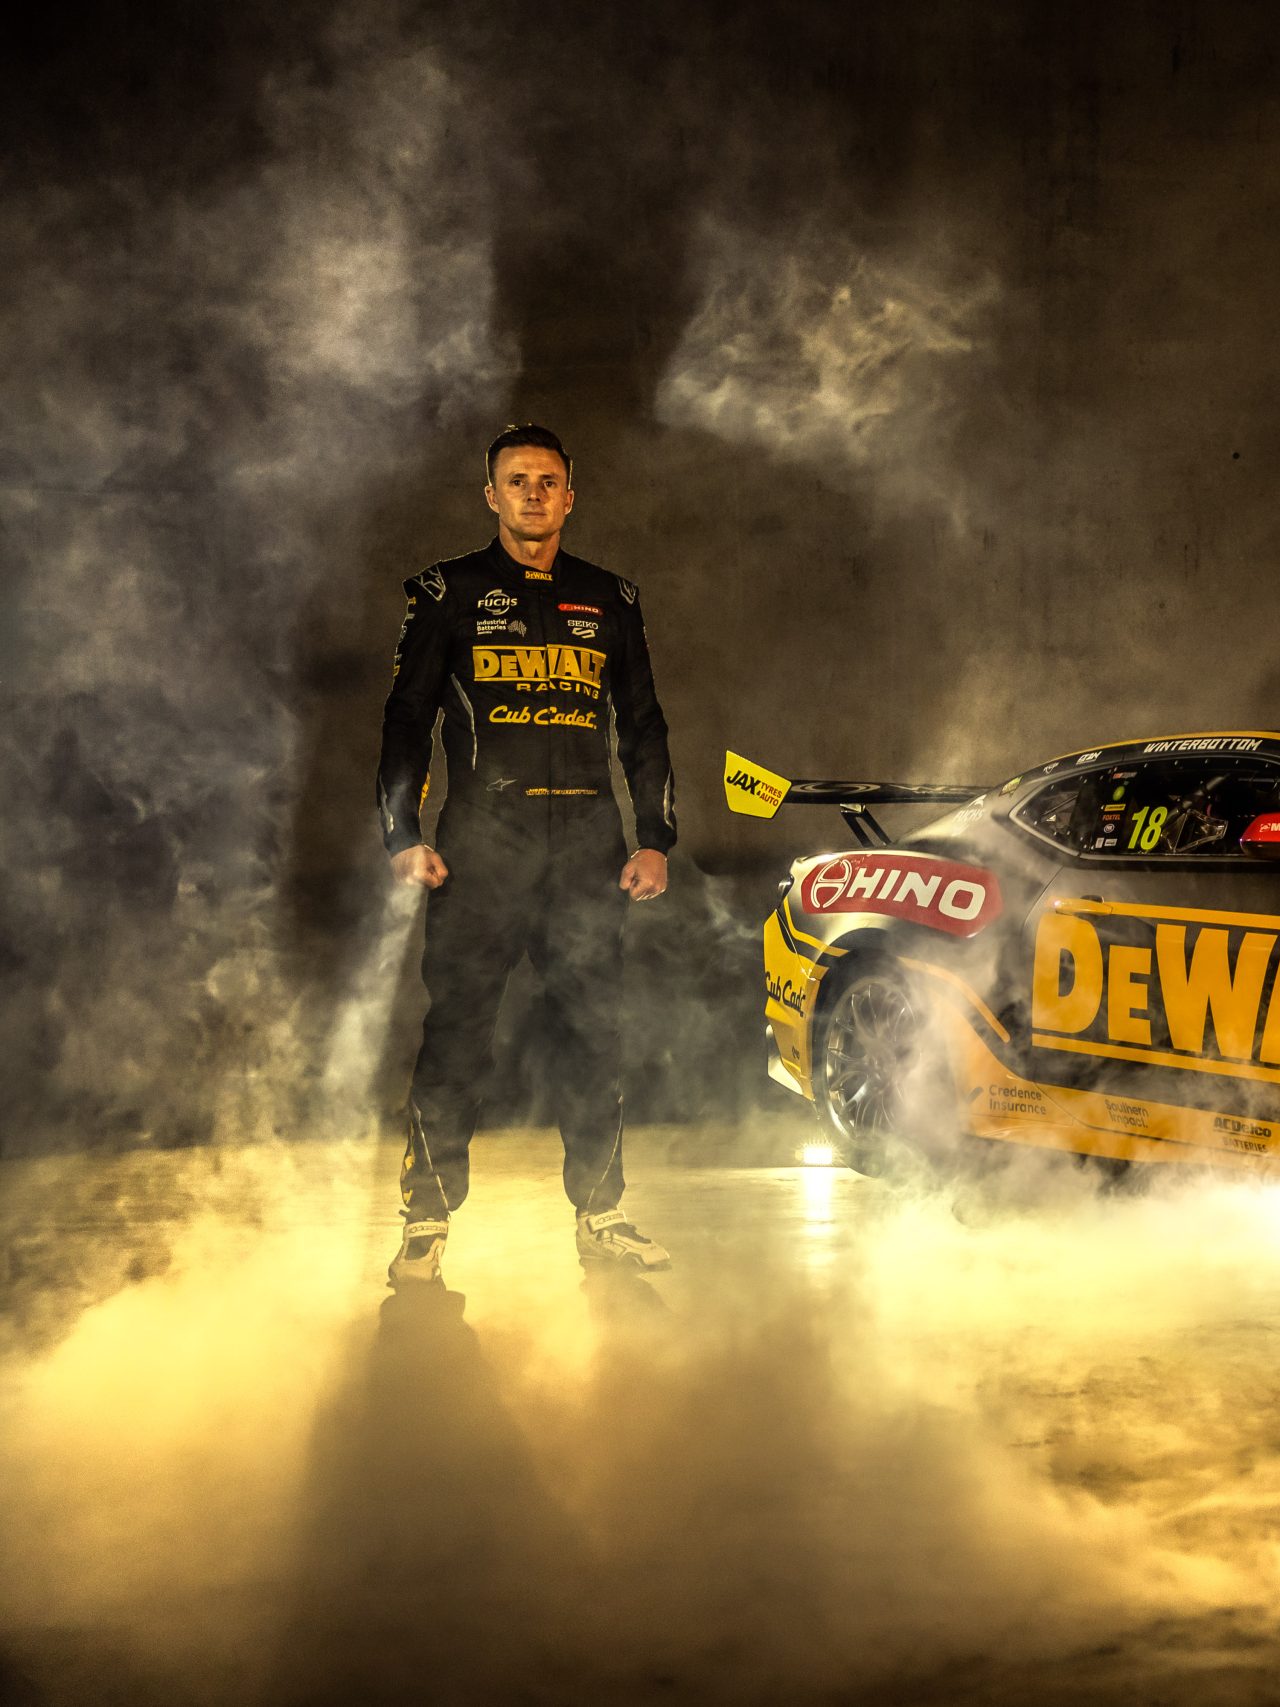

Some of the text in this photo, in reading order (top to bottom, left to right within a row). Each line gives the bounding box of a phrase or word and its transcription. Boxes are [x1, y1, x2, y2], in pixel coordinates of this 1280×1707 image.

[477, 598, 518, 609] FUCHS
[574, 605, 600, 613] HINO
[568, 620, 599, 630] SEIKO
[473, 648, 605, 685] DEWALT
[516, 681, 599, 700] RACING
[489, 705, 531, 724] Cub
[1143, 739, 1263, 753] WINTERBOTTOM
[726, 770, 761, 796] JAX
[760, 782, 783, 799] TYRES
[760, 794, 779, 807] AUTO
[1127, 806, 1168, 850] 18
[846, 867, 986, 921] HINO
[988, 1084, 1042, 1101] Credence
[989, 1098, 1047, 1115] Insurance
[1214, 1116, 1272, 1138] ACDelco
